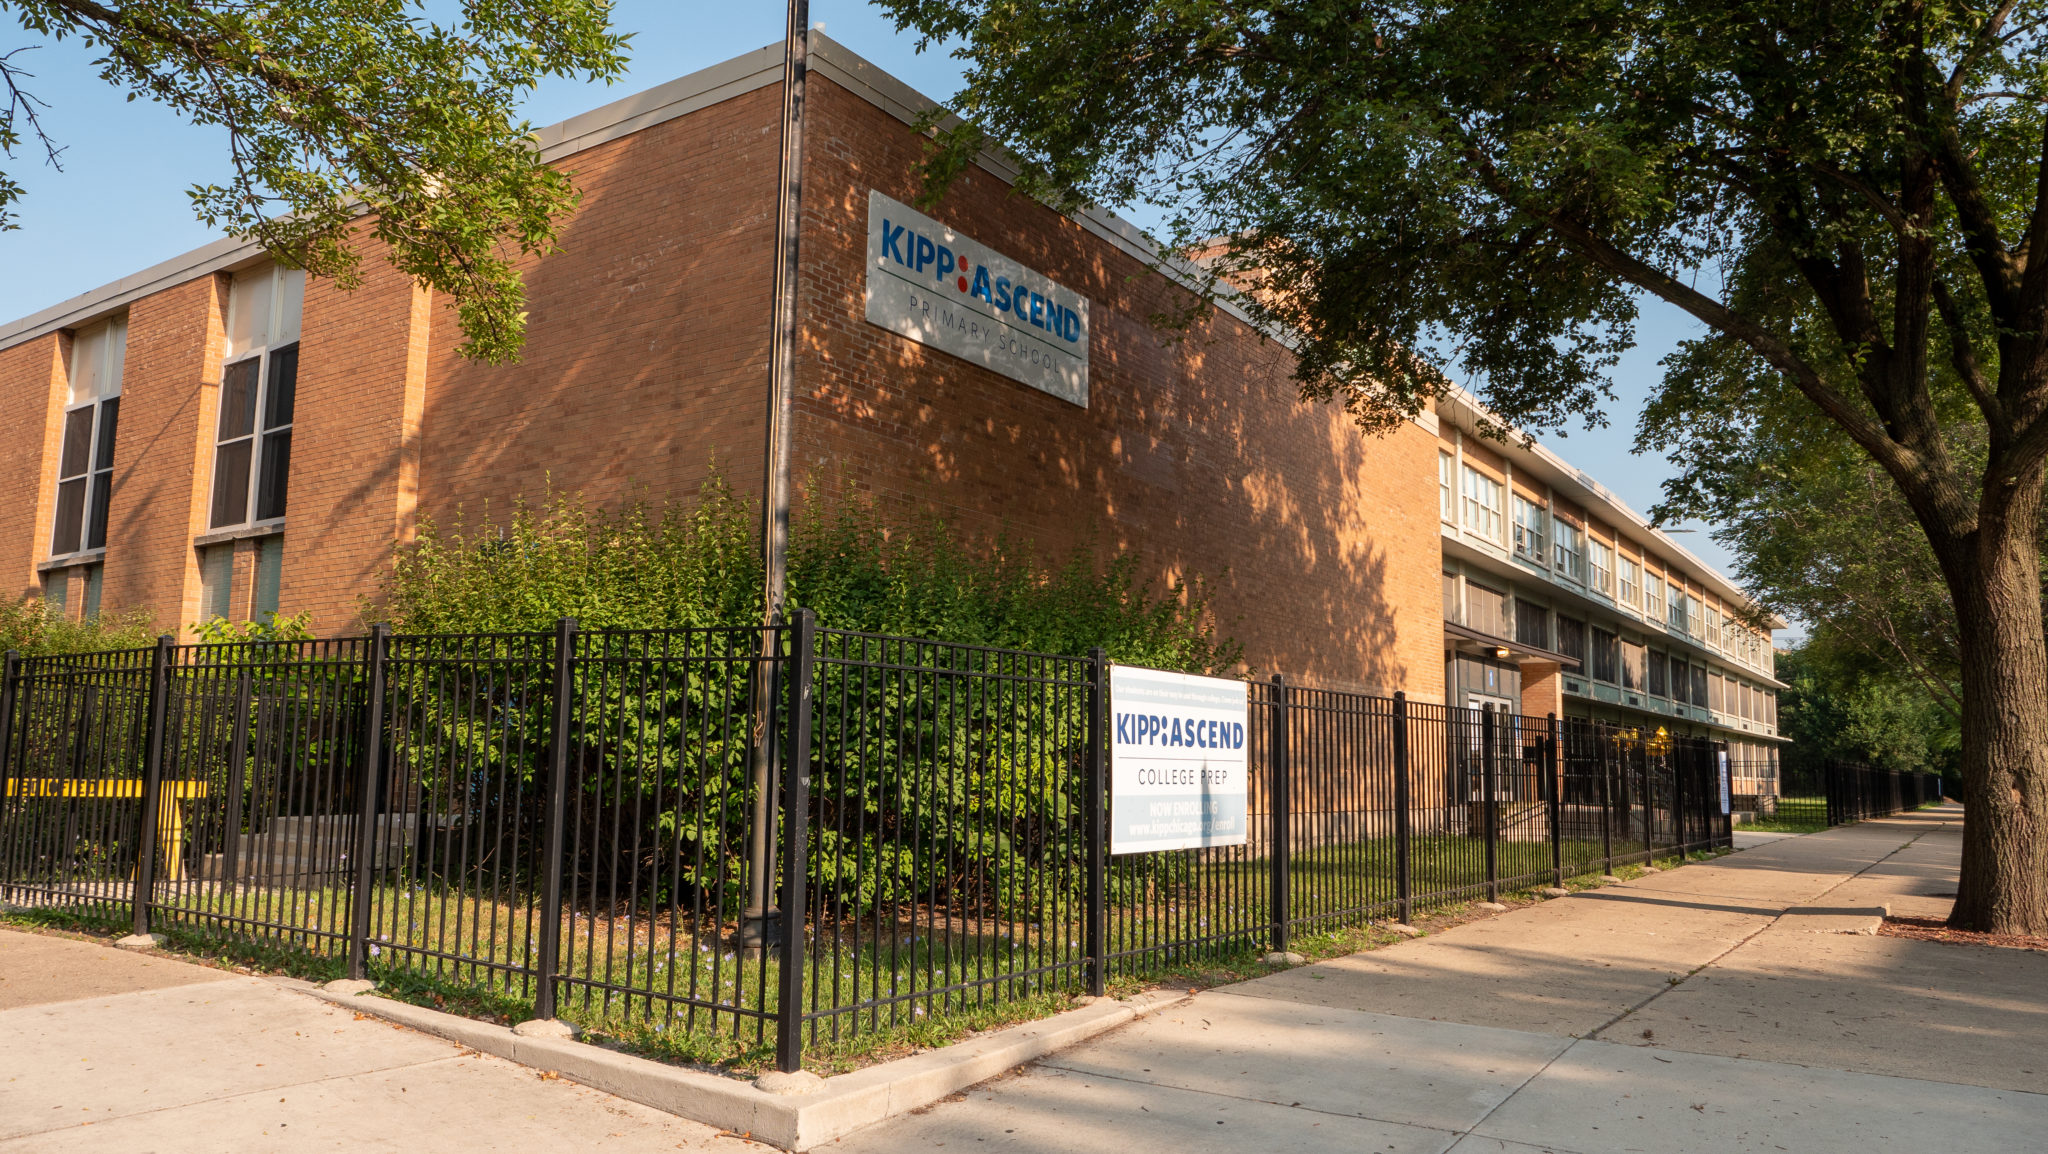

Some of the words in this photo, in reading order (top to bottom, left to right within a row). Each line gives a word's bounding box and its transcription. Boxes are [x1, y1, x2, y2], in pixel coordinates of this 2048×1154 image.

[909, 295, 990, 342] PRIMARY
[999, 334, 1059, 373] SCHOOL
[1138, 768, 1194, 785] COLLEGE
[1201, 769, 1228, 785] PREP
[1149, 801, 1172, 817] NOW
[1173, 800, 1218, 816] ENROLLING
